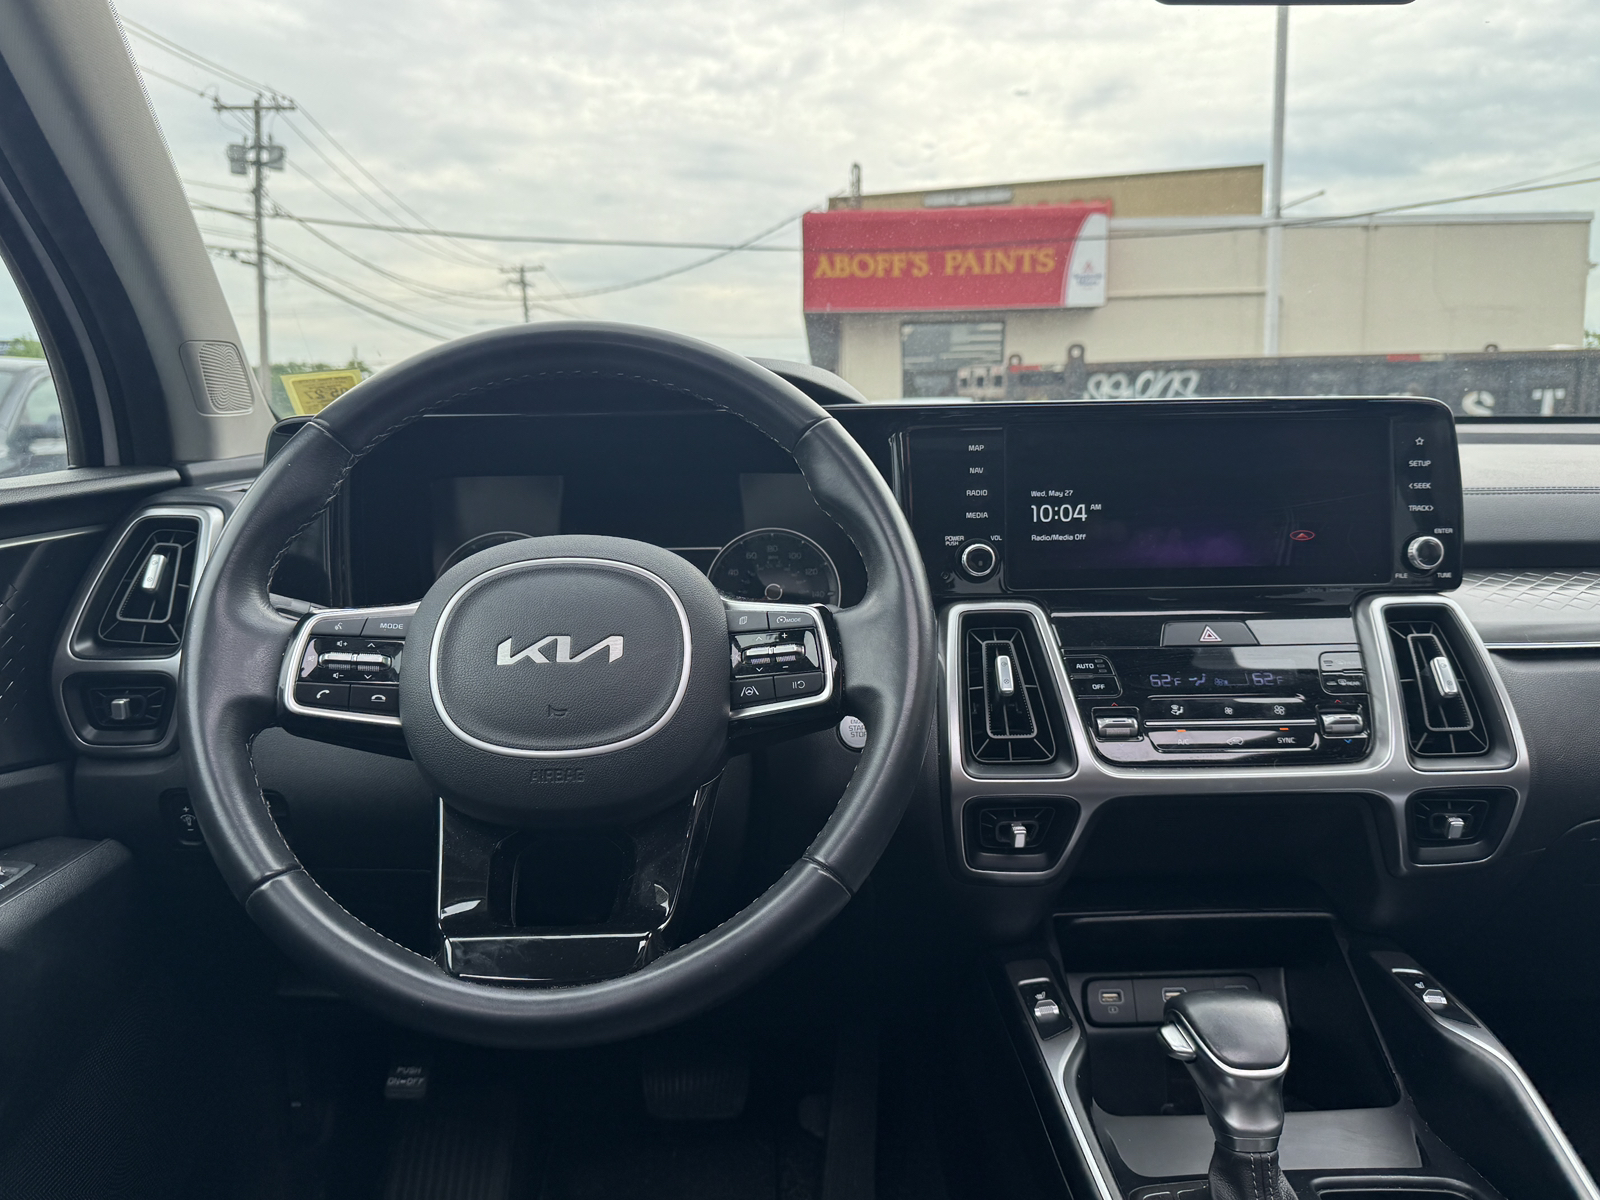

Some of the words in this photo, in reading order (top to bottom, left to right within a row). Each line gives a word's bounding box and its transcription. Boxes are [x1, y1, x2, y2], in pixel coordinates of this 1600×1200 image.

[814, 251, 930, 279] ABOFF'S
[944, 248, 1057, 277] PAINTS
[968, 444, 985, 452] MAP
[966, 489, 988, 497] RADIO
[1030, 490, 1047, 498] Wed,
[1048, 490, 1063, 498] May
[1064, 489, 1073, 497] 27
[1031, 504, 1088, 523] 10:04
[1074, 533, 1087, 541] Off
[379, 622, 404, 630] MODE
[497, 634, 624, 666] KIA
[529, 768, 585, 784] AIRBAG
